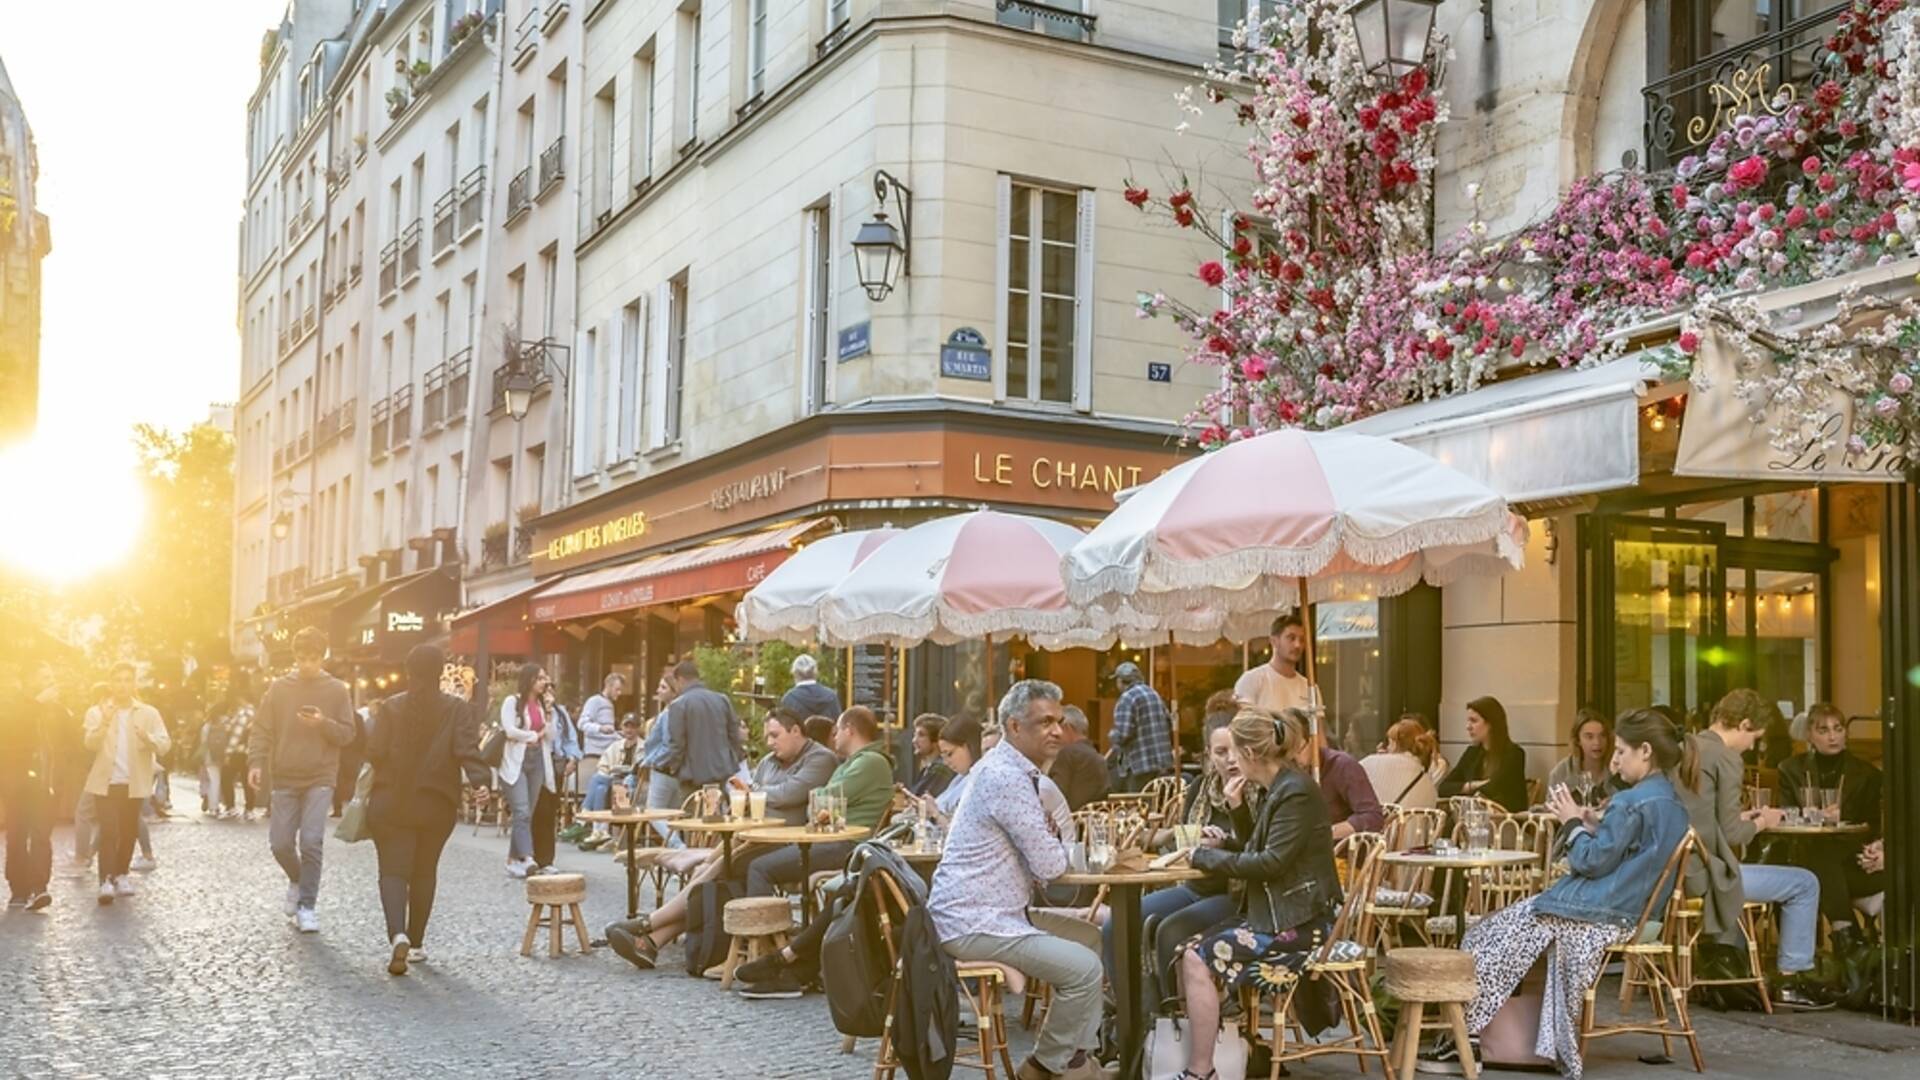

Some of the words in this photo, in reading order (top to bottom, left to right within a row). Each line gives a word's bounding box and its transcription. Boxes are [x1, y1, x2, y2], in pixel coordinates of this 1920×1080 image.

[1151, 365, 1168, 380] 57
[712, 466, 786, 510] RESTAURANT
[974, 452, 1013, 485] LE
[1032, 457, 1142, 493] CHANT
